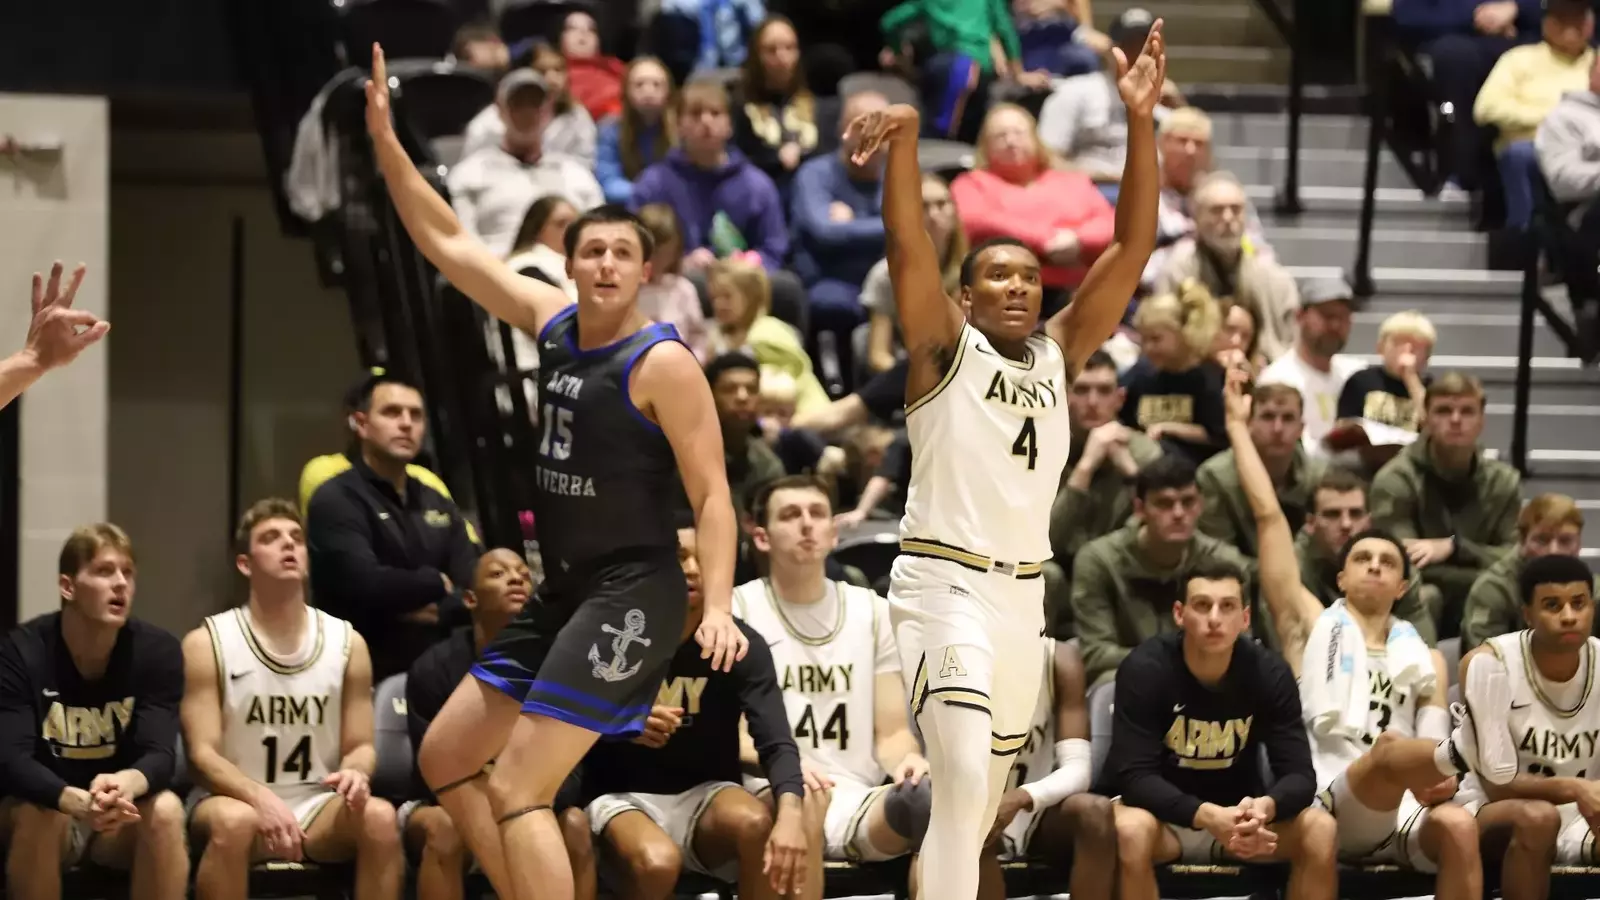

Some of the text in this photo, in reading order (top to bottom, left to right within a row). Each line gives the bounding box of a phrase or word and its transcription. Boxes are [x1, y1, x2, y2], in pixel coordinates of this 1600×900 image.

[546, 371, 584, 400] ACTA
[539, 402, 574, 461] 15
[1011, 416, 1038, 470] 4
[782, 663, 853, 693] ARMY
[939, 645, 968, 679] A
[42, 696, 135, 746] ARMY
[245, 695, 330, 726] ARMY
[795, 702, 849, 751] 44
[1163, 714, 1254, 758] ARMY
[1518, 727, 1600, 759] ARMY
[262, 734, 312, 784] 14
